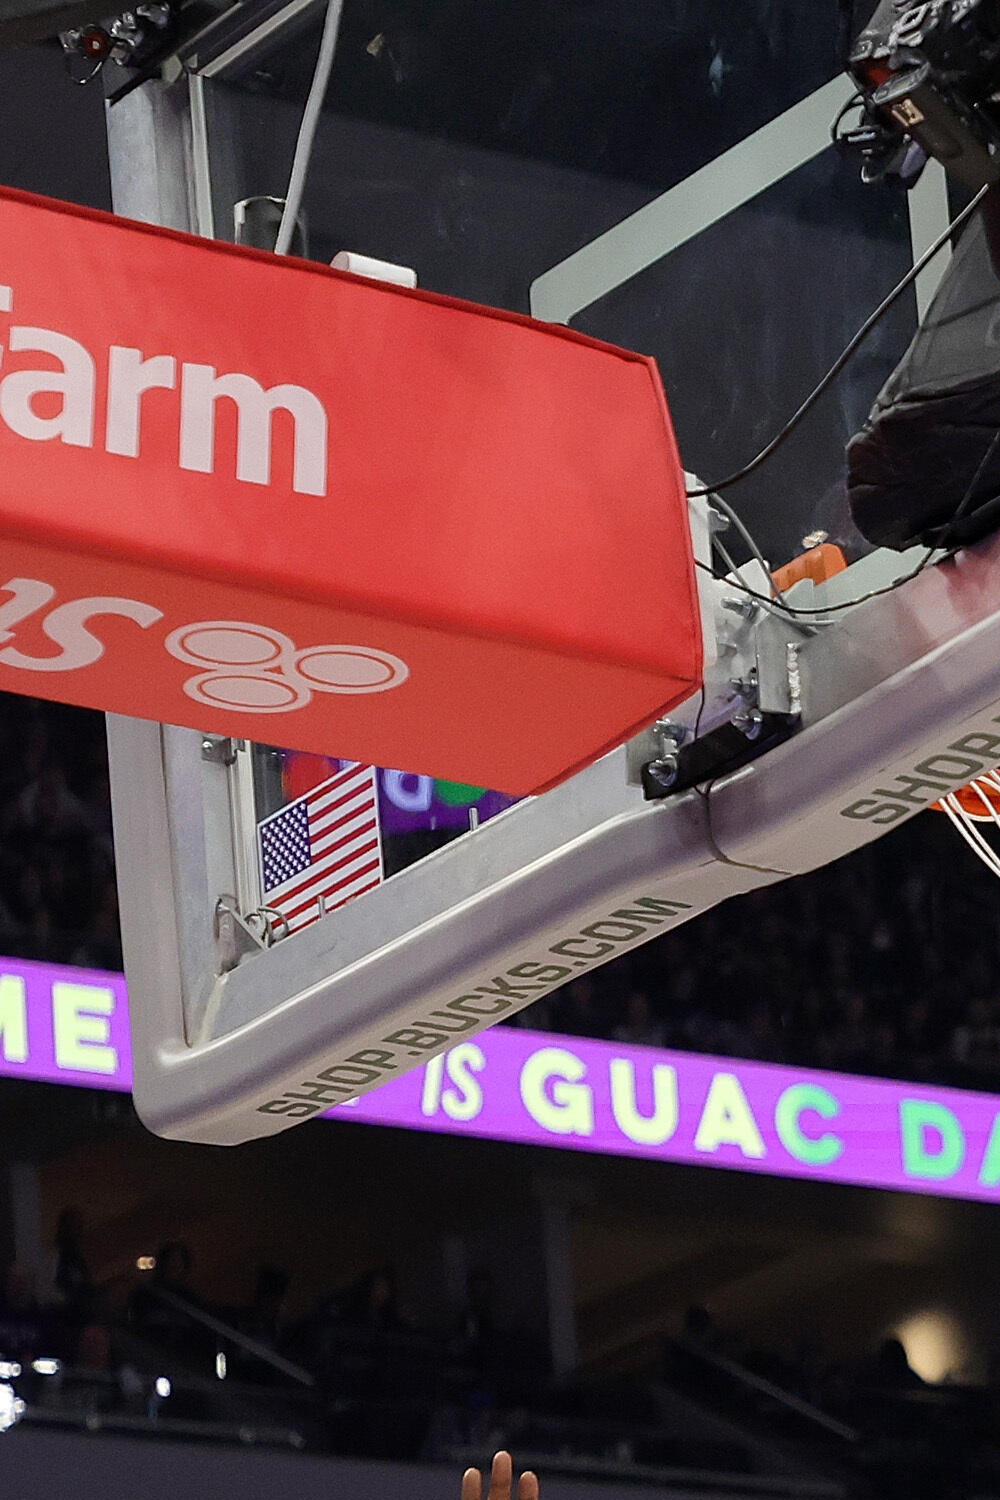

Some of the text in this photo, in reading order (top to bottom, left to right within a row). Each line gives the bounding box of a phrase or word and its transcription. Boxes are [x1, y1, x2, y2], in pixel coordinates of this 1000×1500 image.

[0, 284, 328, 497] arm
[256, 896, 693, 1119] SHOP.BUCKS.COM
[421, 1041, 487, 1123] IS
[519, 1046, 845, 1167] GUAC
